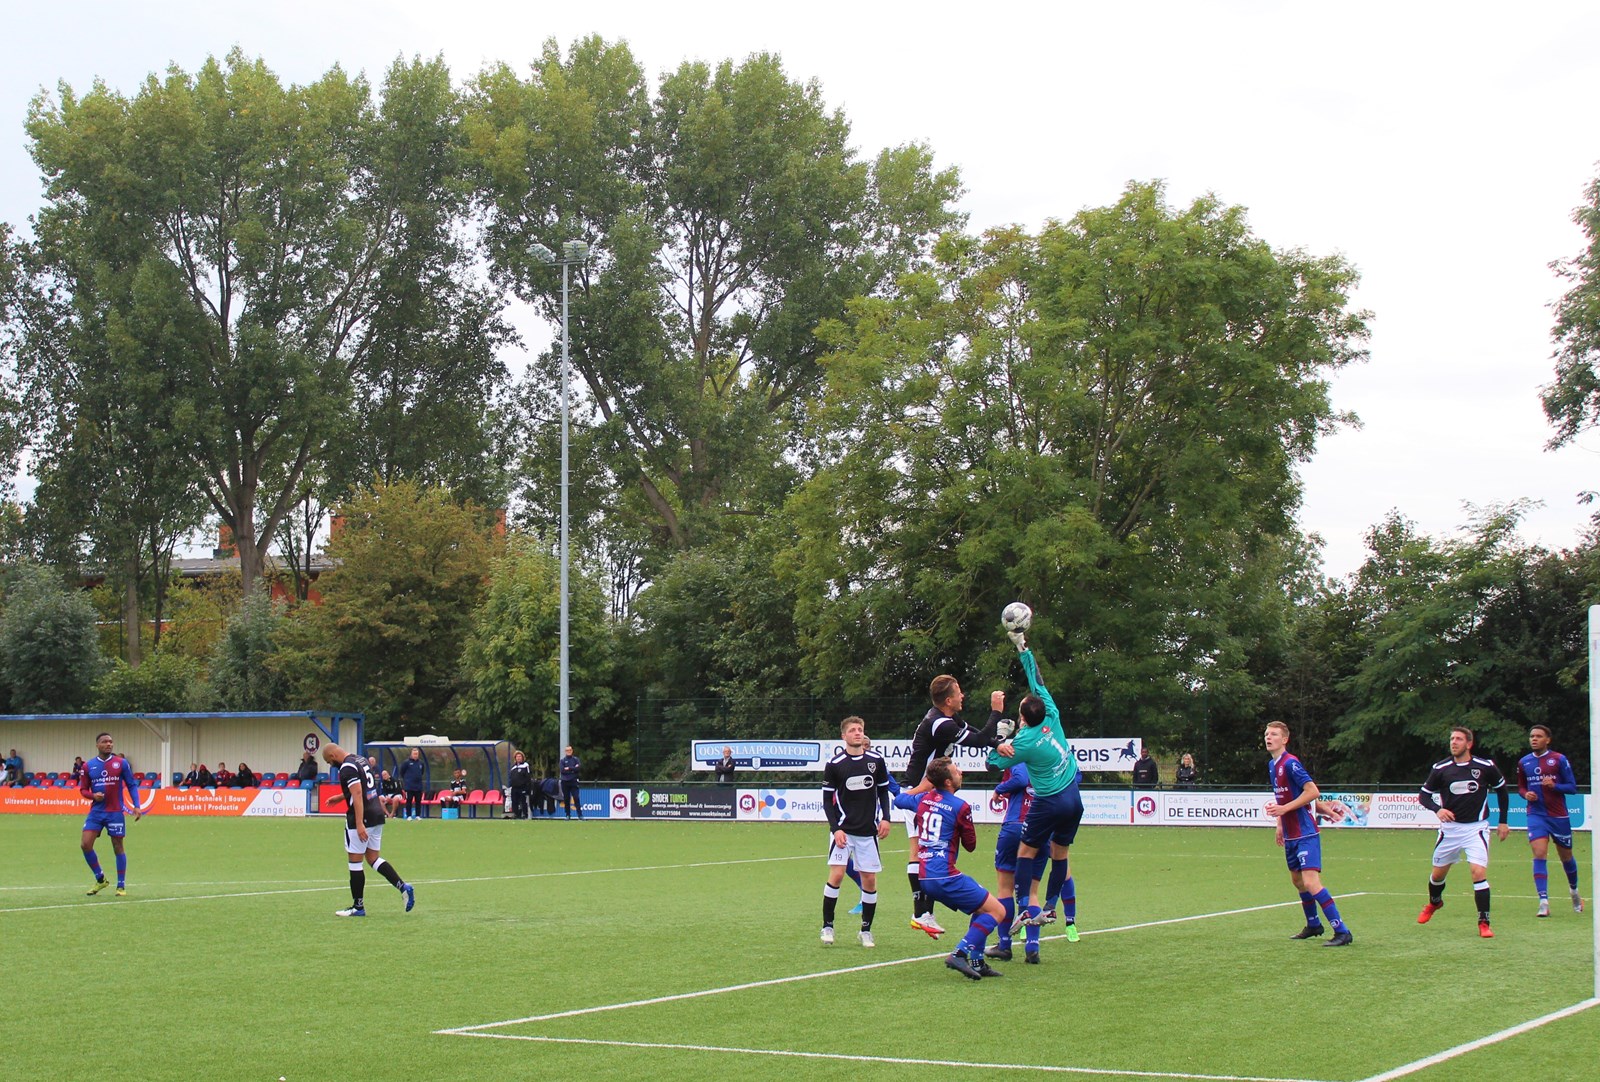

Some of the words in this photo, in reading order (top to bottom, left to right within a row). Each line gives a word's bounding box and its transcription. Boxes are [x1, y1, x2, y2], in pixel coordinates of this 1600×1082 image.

[1070, 745, 1110, 762] tens
[363, 765, 375, 789] 5
[1168, 808, 1184, 817] DE
[1187, 808, 1259, 818] EENDRACHT
[1378, 811, 1417, 820] company
[920, 811, 944, 841] 19
[834, 853, 843, 861] 19
